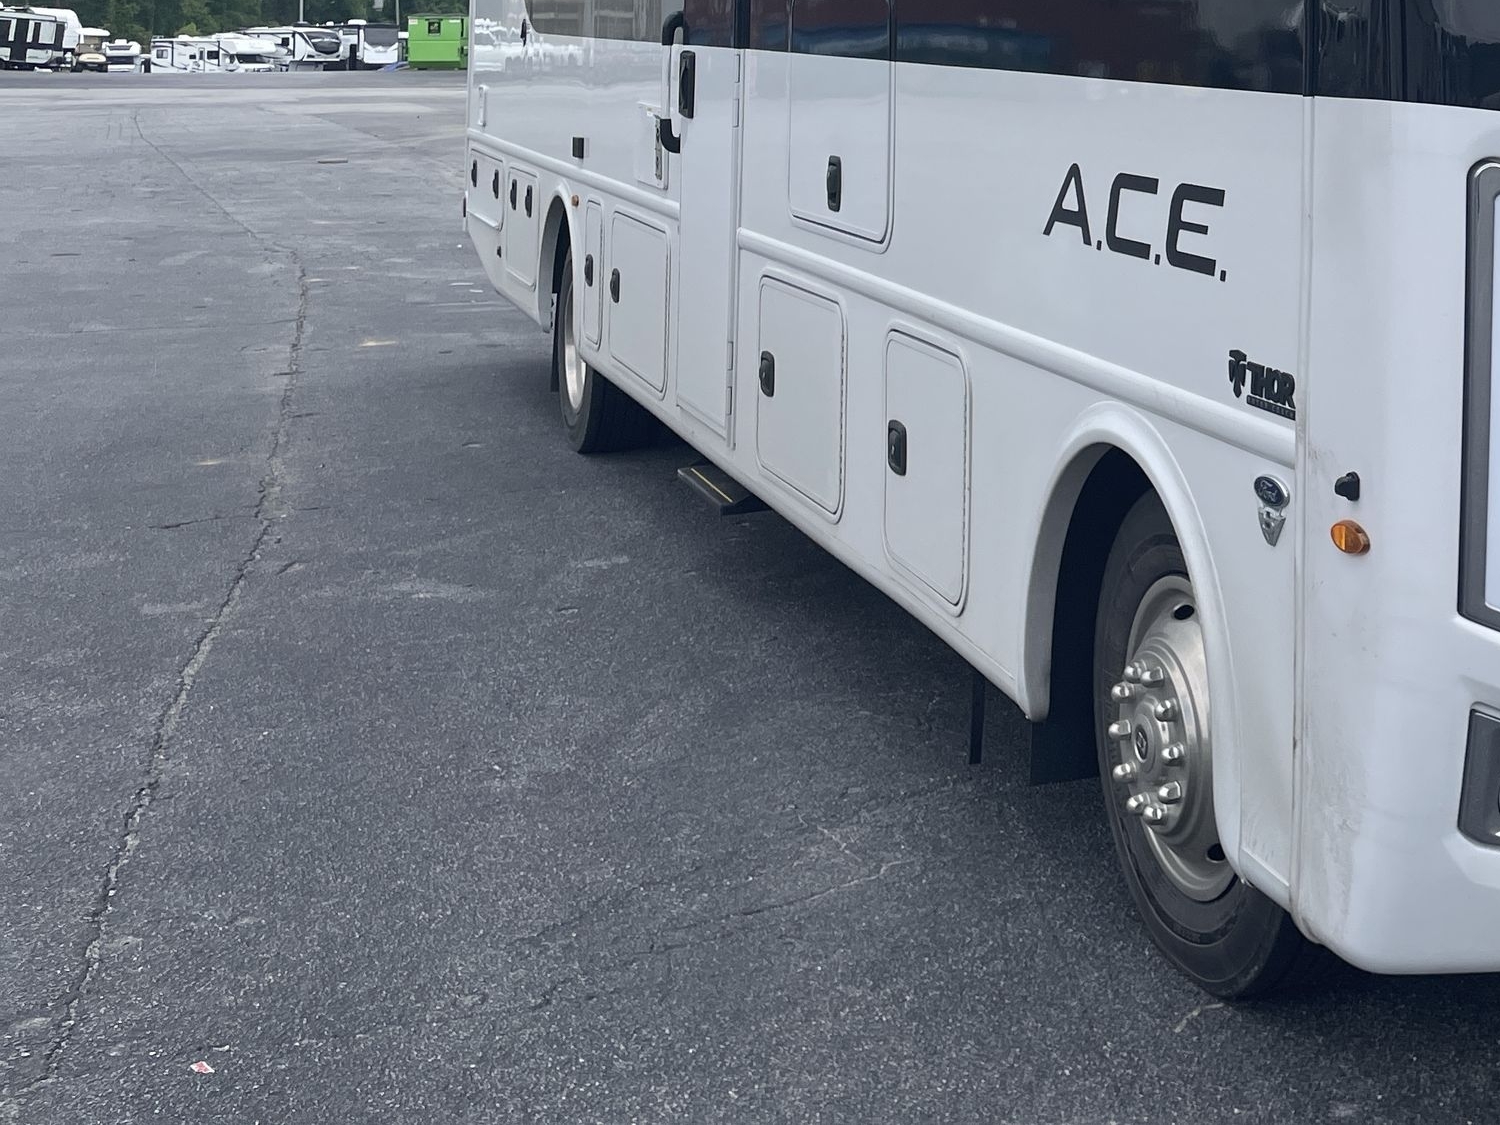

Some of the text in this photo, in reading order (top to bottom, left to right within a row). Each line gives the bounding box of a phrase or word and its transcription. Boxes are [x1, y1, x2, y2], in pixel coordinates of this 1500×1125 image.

[1042, 162, 1227, 283] A.C.E.
[1246, 361, 1296, 410] THOR
[1258, 479, 1279, 503] Ford
